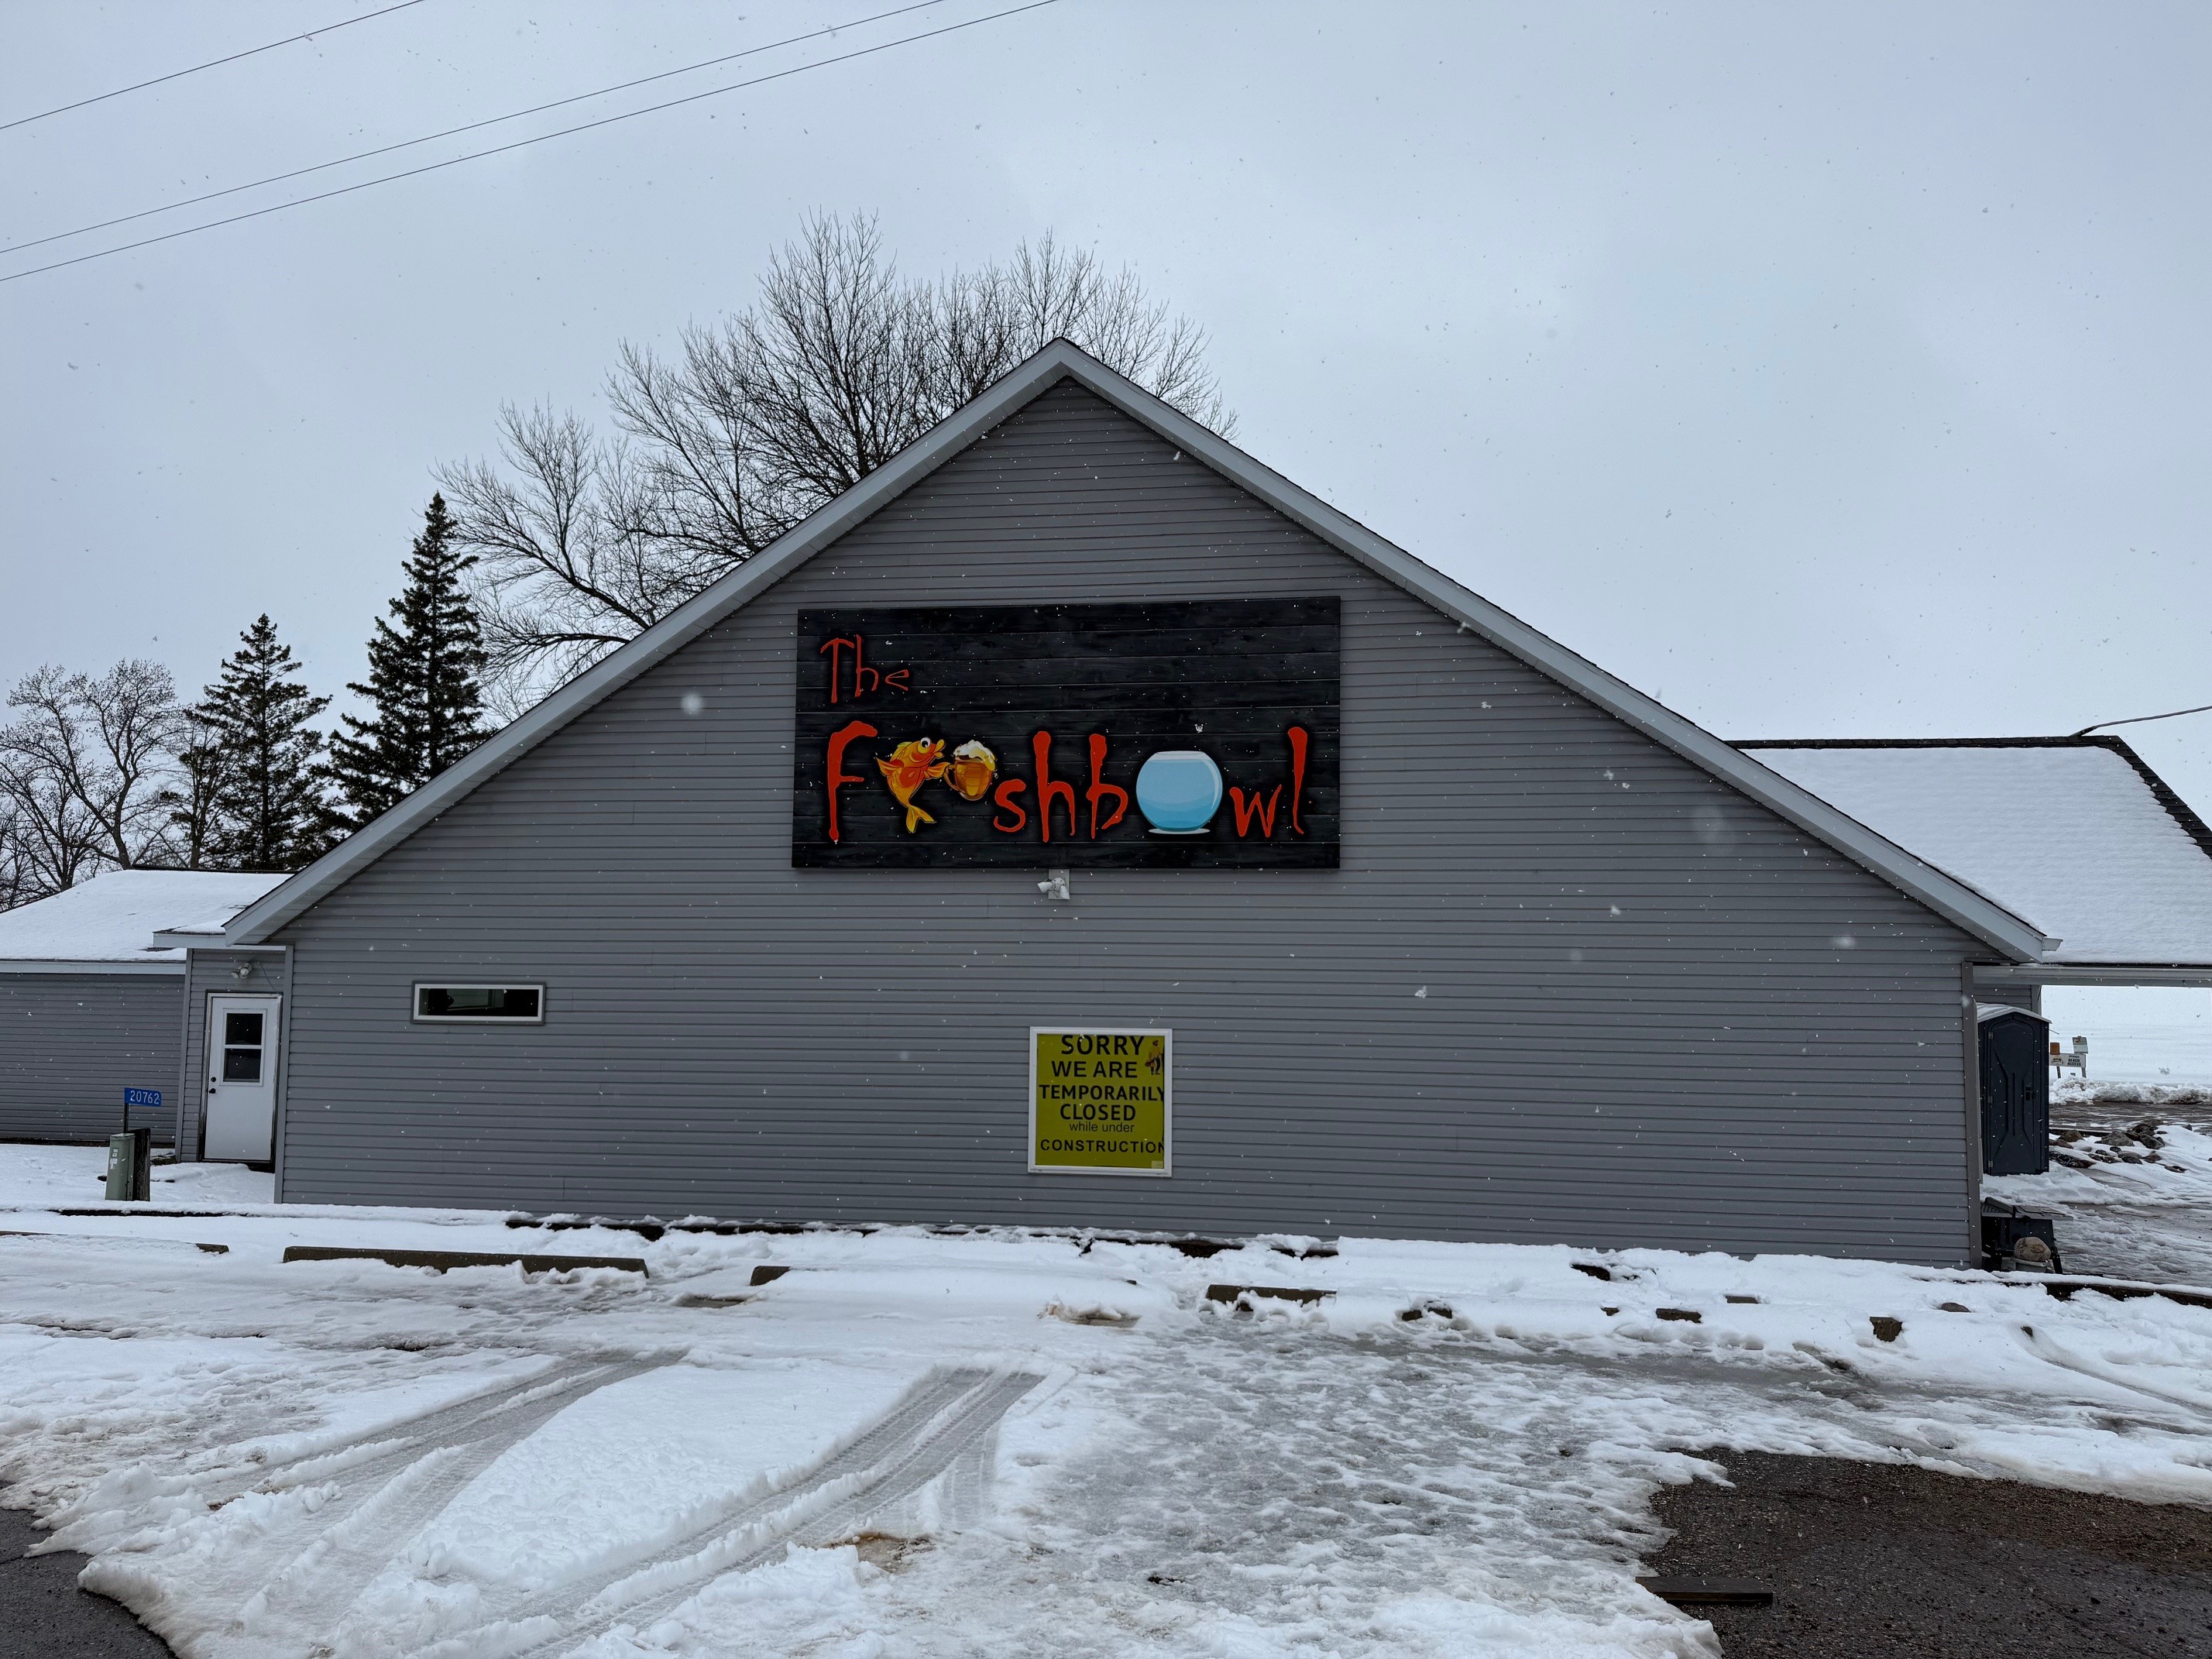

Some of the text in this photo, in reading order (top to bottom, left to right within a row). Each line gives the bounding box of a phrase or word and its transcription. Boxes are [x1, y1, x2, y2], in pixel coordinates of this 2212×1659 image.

[820, 634, 910, 703] The
[1061, 1035, 1145, 1055] SORRY
[1051, 1060, 1138, 1078] WE ARE
[130, 1091, 160, 1104] 20762
[1039, 1084, 1164, 1101] TEMPORARILY
[1060, 1104, 1136, 1121] CLOSED
[1070, 1121, 1135, 1133] while under
